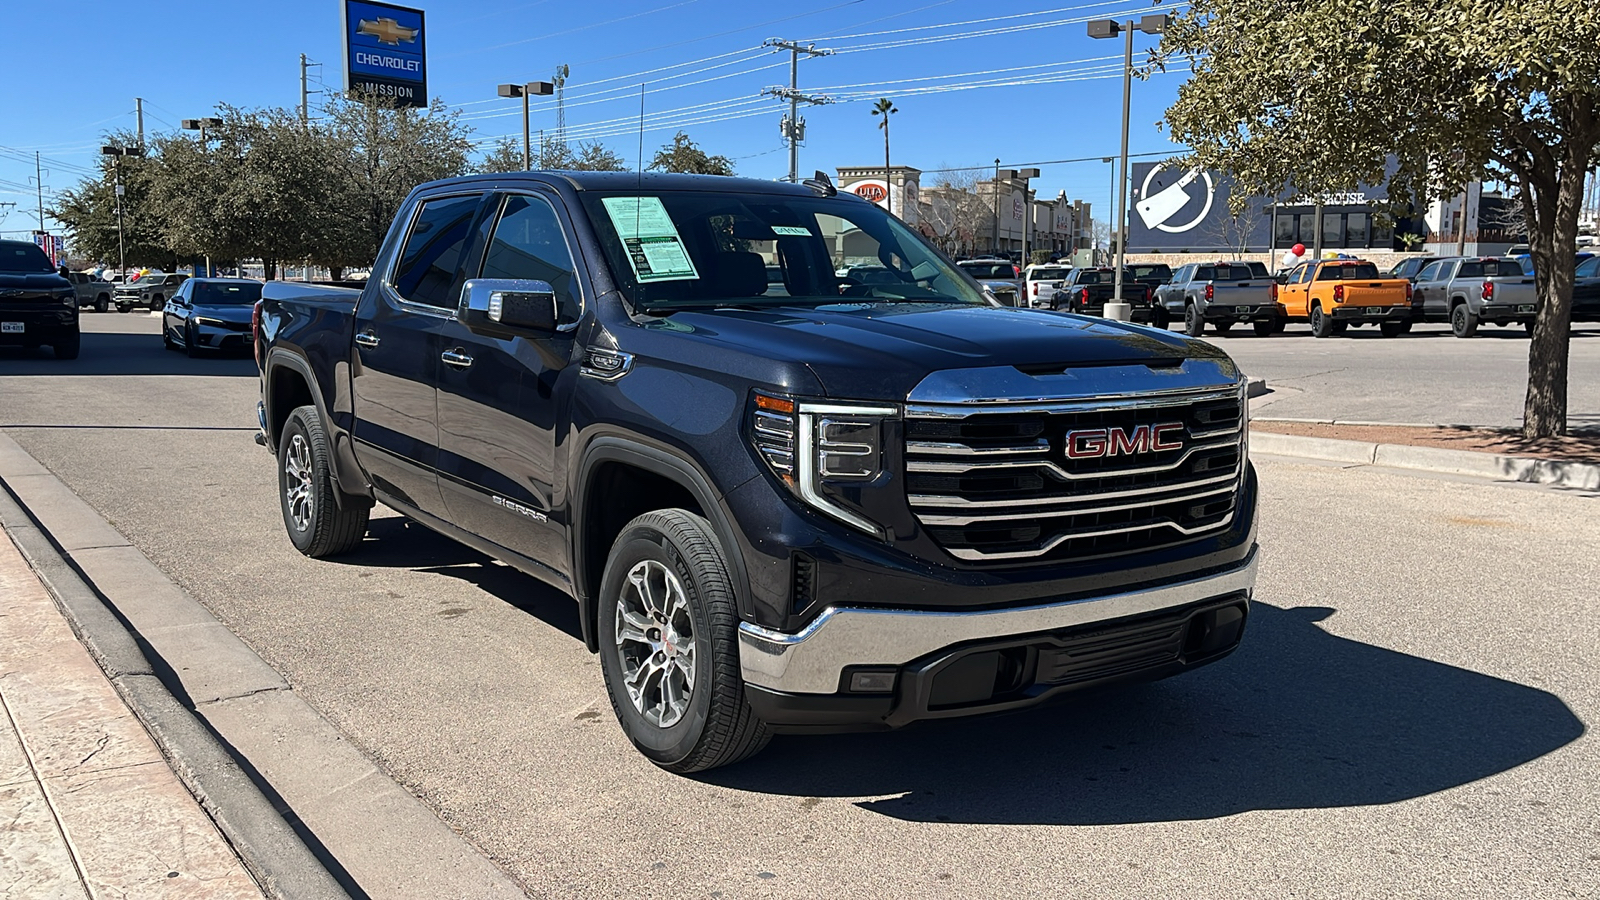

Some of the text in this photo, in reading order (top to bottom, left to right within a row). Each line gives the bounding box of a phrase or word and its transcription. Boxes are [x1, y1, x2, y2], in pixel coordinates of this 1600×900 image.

[356, 52, 420, 72] CHEVROLET
[365, 82, 413, 98] MISSION
[859, 187, 882, 196] ULTA
[1065, 421, 1184, 459] GMC
[492, 495, 548, 523] SIERRA
